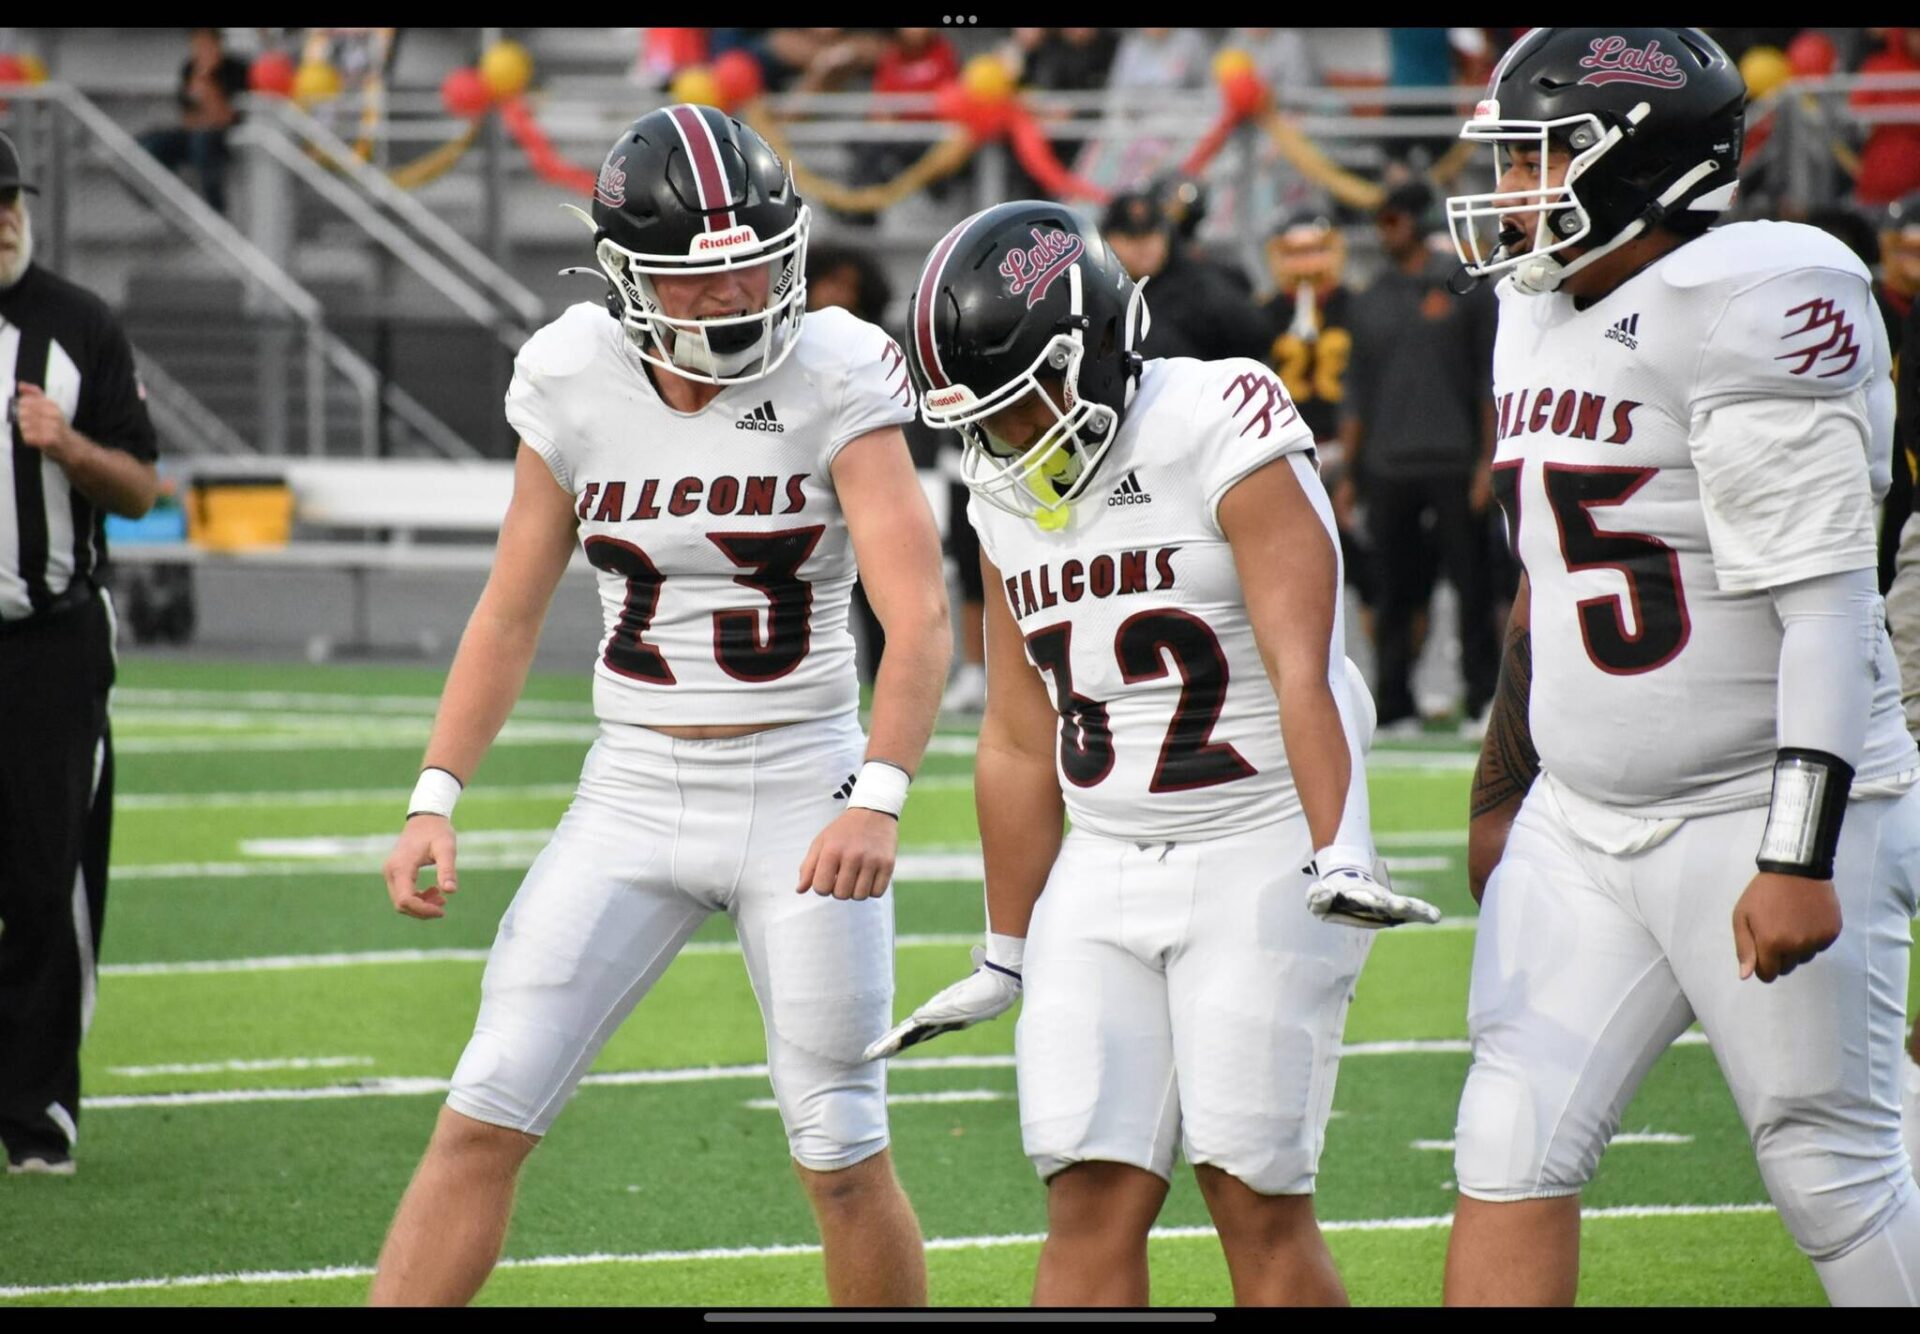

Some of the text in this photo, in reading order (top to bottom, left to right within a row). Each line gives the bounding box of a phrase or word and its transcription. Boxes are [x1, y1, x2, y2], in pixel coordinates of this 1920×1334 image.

[1580, 36, 1679, 76] Lake
[699, 231, 751, 250] Riddell
[1000, 228, 1071, 295] Lake
[1604, 329, 1639, 350] adidas
[736, 419, 785, 433] adidas
[1498, 387, 1643, 445] ALCONS
[577, 473, 811, 522] FALCONS
[1107, 492, 1152, 507] adidas
[584, 524, 826, 686] 23
[1005, 547, 1182, 621] FALCONS
